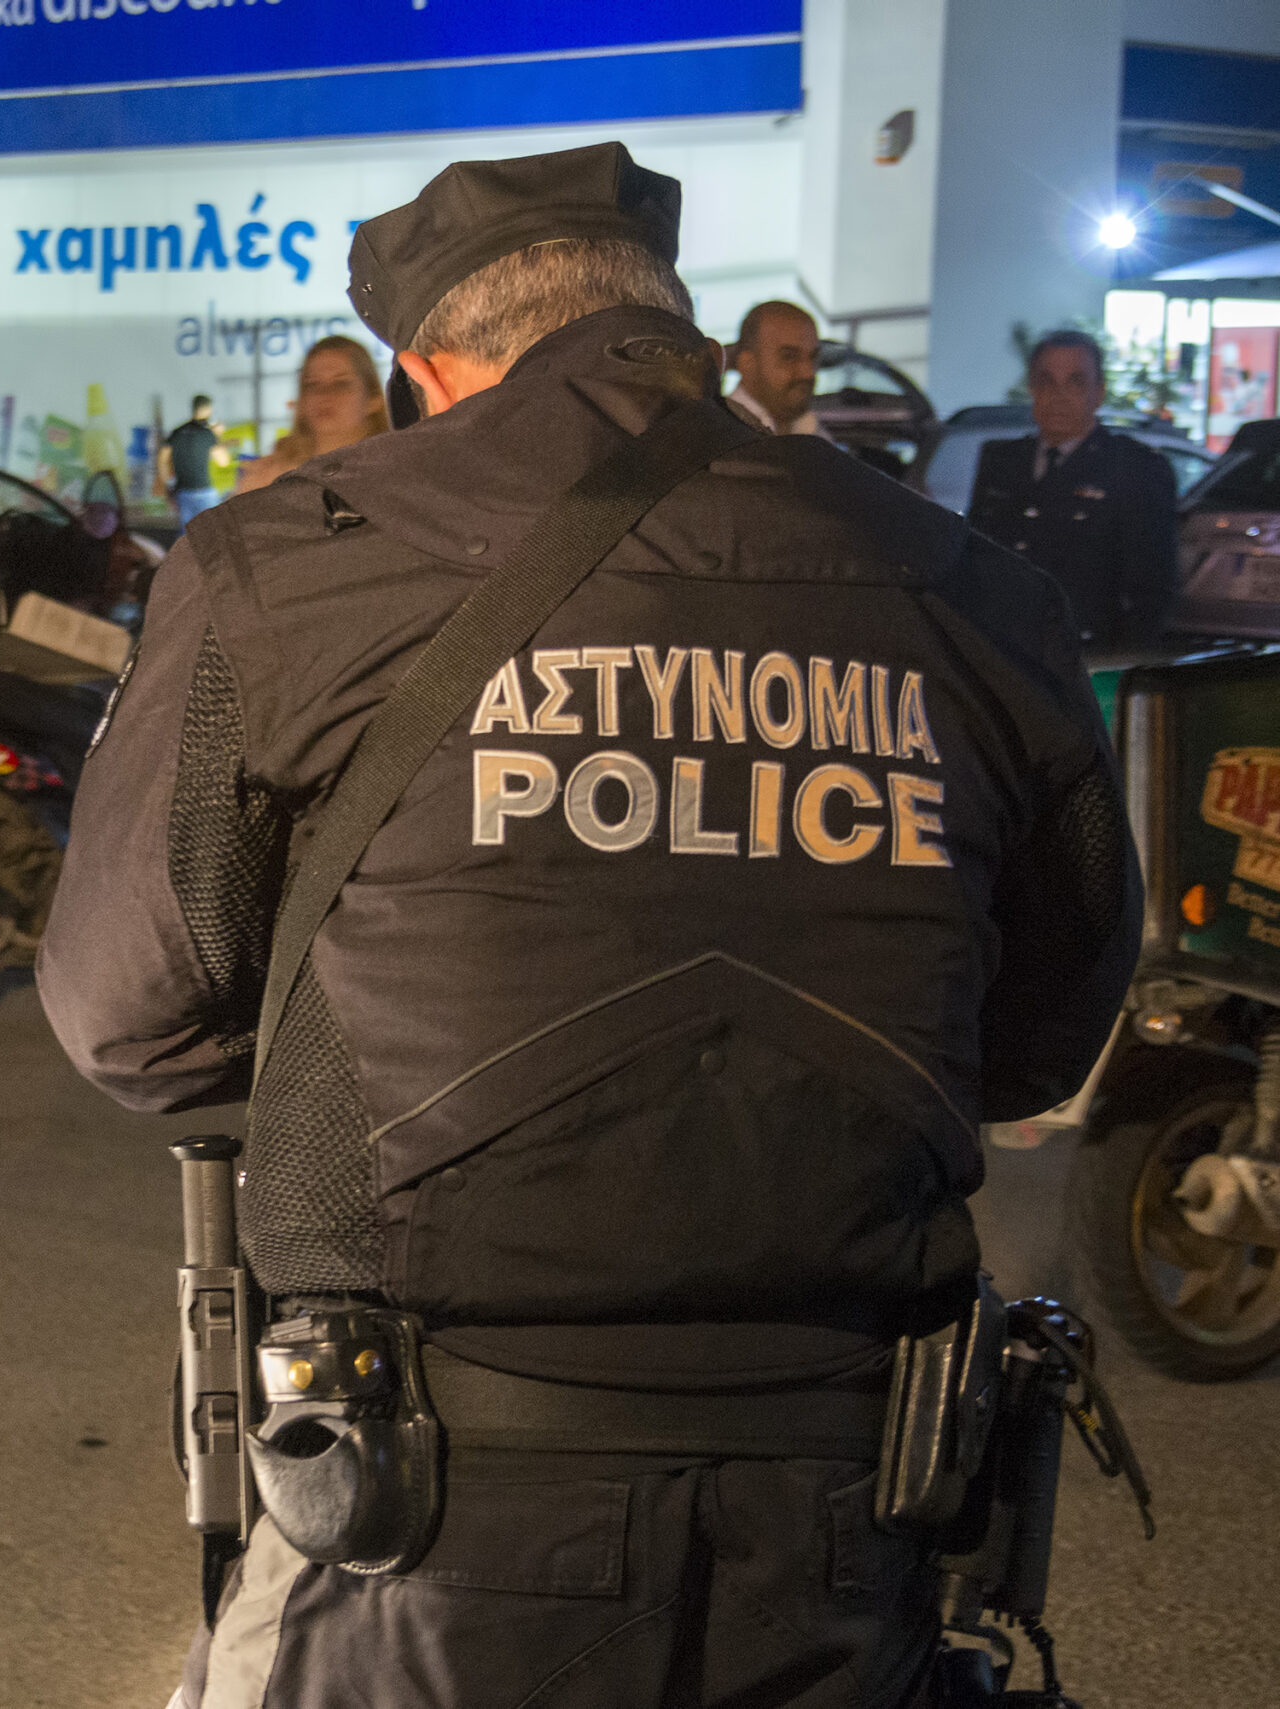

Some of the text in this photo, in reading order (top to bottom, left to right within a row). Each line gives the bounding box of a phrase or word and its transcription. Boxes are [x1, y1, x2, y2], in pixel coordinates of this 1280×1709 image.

[15, 192, 317, 292] χαμηλές
[470, 645, 941, 764] ΑΣΤΥΝΟΜΙΑ
[472, 749, 954, 868] POLICE
